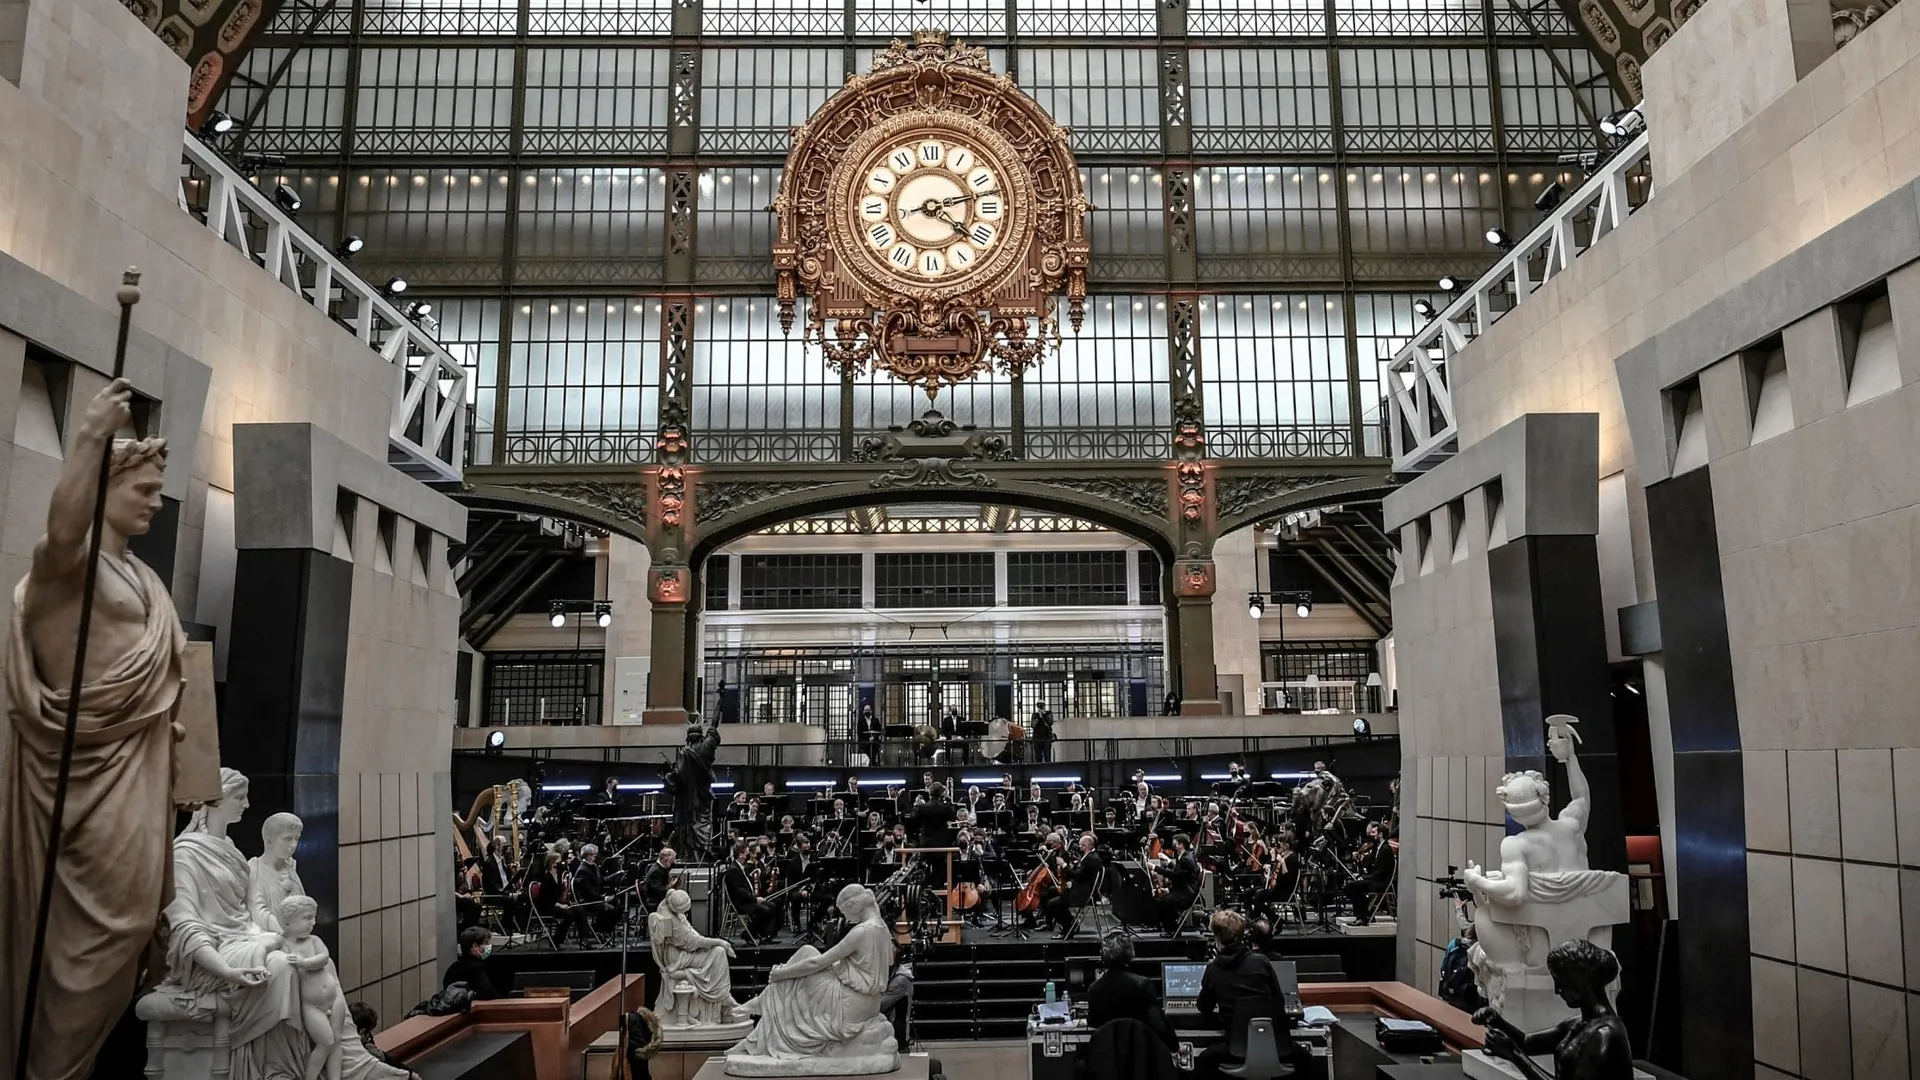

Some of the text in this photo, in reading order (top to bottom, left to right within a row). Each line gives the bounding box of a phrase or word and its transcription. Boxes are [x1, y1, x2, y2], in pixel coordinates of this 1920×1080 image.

[894, 152, 911, 169] XI
[923, 145, 939, 161] XII
[873, 174, 889, 188] X
[973, 174, 990, 187] II
[866, 202, 882, 214] IX
[981, 202, 997, 214] III
[870, 224, 891, 248] VIII
[971, 225, 992, 246] IIII
[892, 246, 911, 267] VII
[925, 256, 939, 271] VI
[956, 249, 968, 264] V
